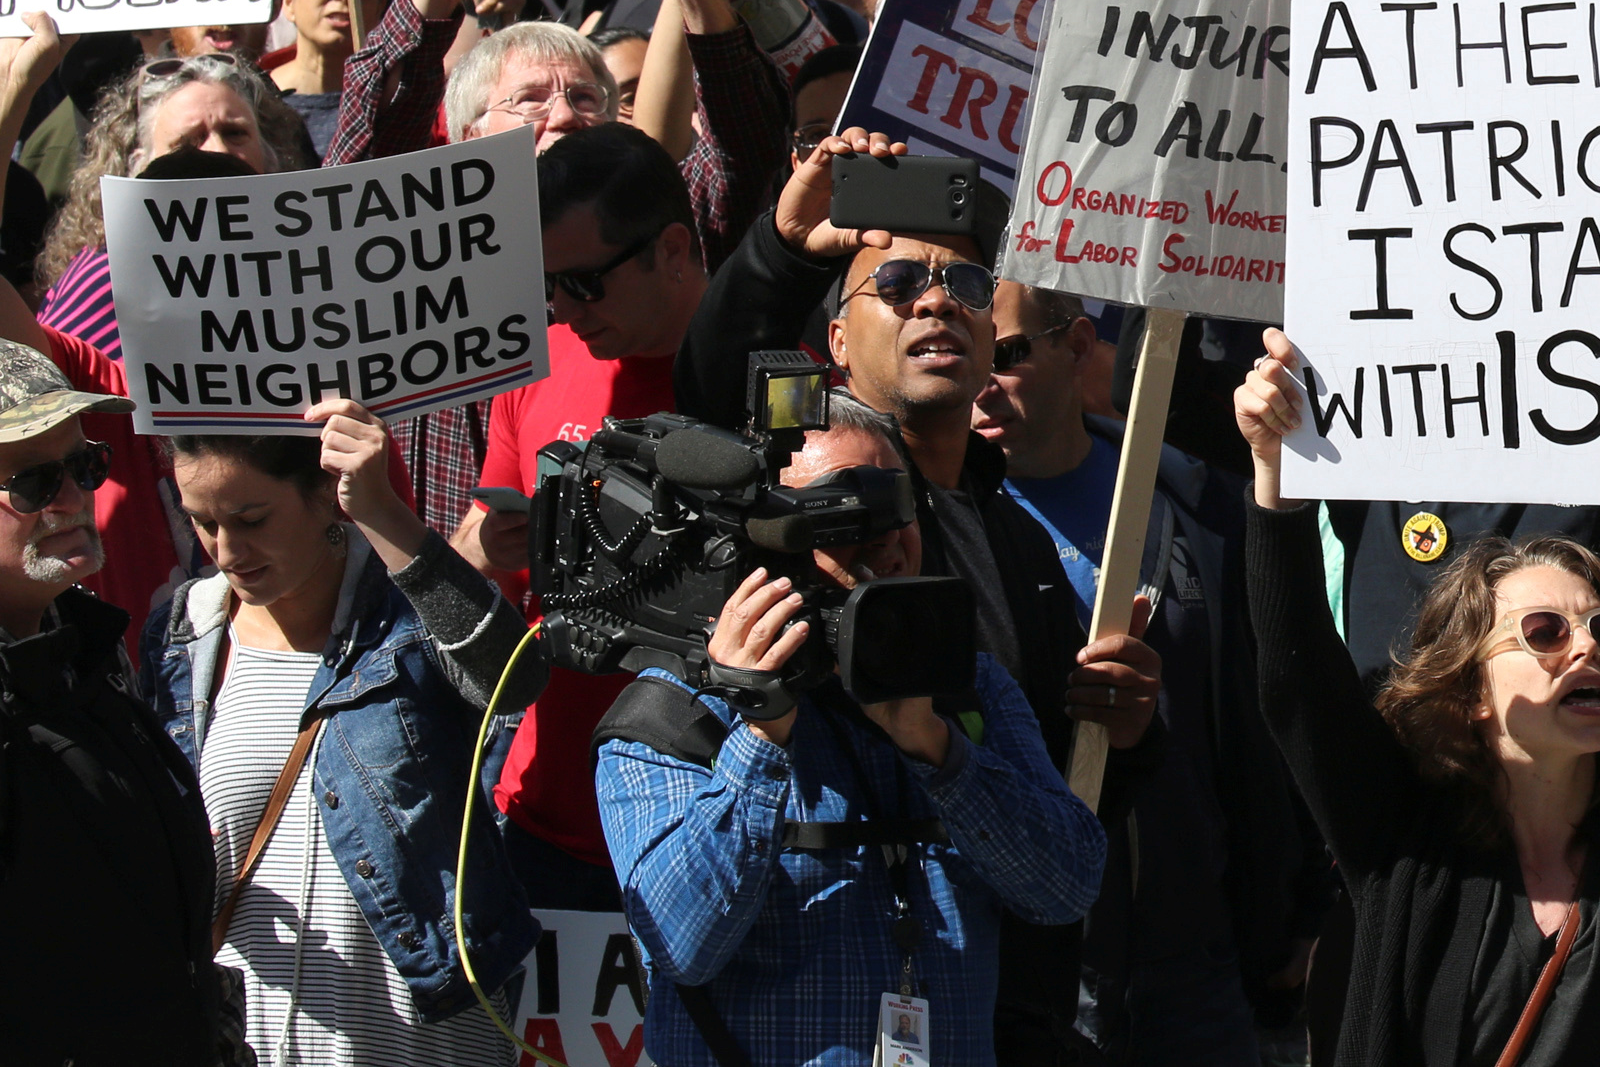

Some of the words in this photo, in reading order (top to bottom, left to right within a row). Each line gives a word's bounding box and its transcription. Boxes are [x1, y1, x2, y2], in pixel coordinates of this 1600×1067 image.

[1062, 84, 1138, 147] TO
[144, 195, 253, 243] WE
[274, 157, 495, 239] STAND
[1015, 220, 1051, 254] for
[152, 249, 332, 299] WITH
[354, 213, 500, 283] OUR
[1347, 227, 1414, 321] I
[200, 276, 468, 353] MUSLIM
[145, 314, 531, 407] NEIGHBORS
[1303, 360, 1489, 440] WITH
[804, 499, 829, 509] SONY
